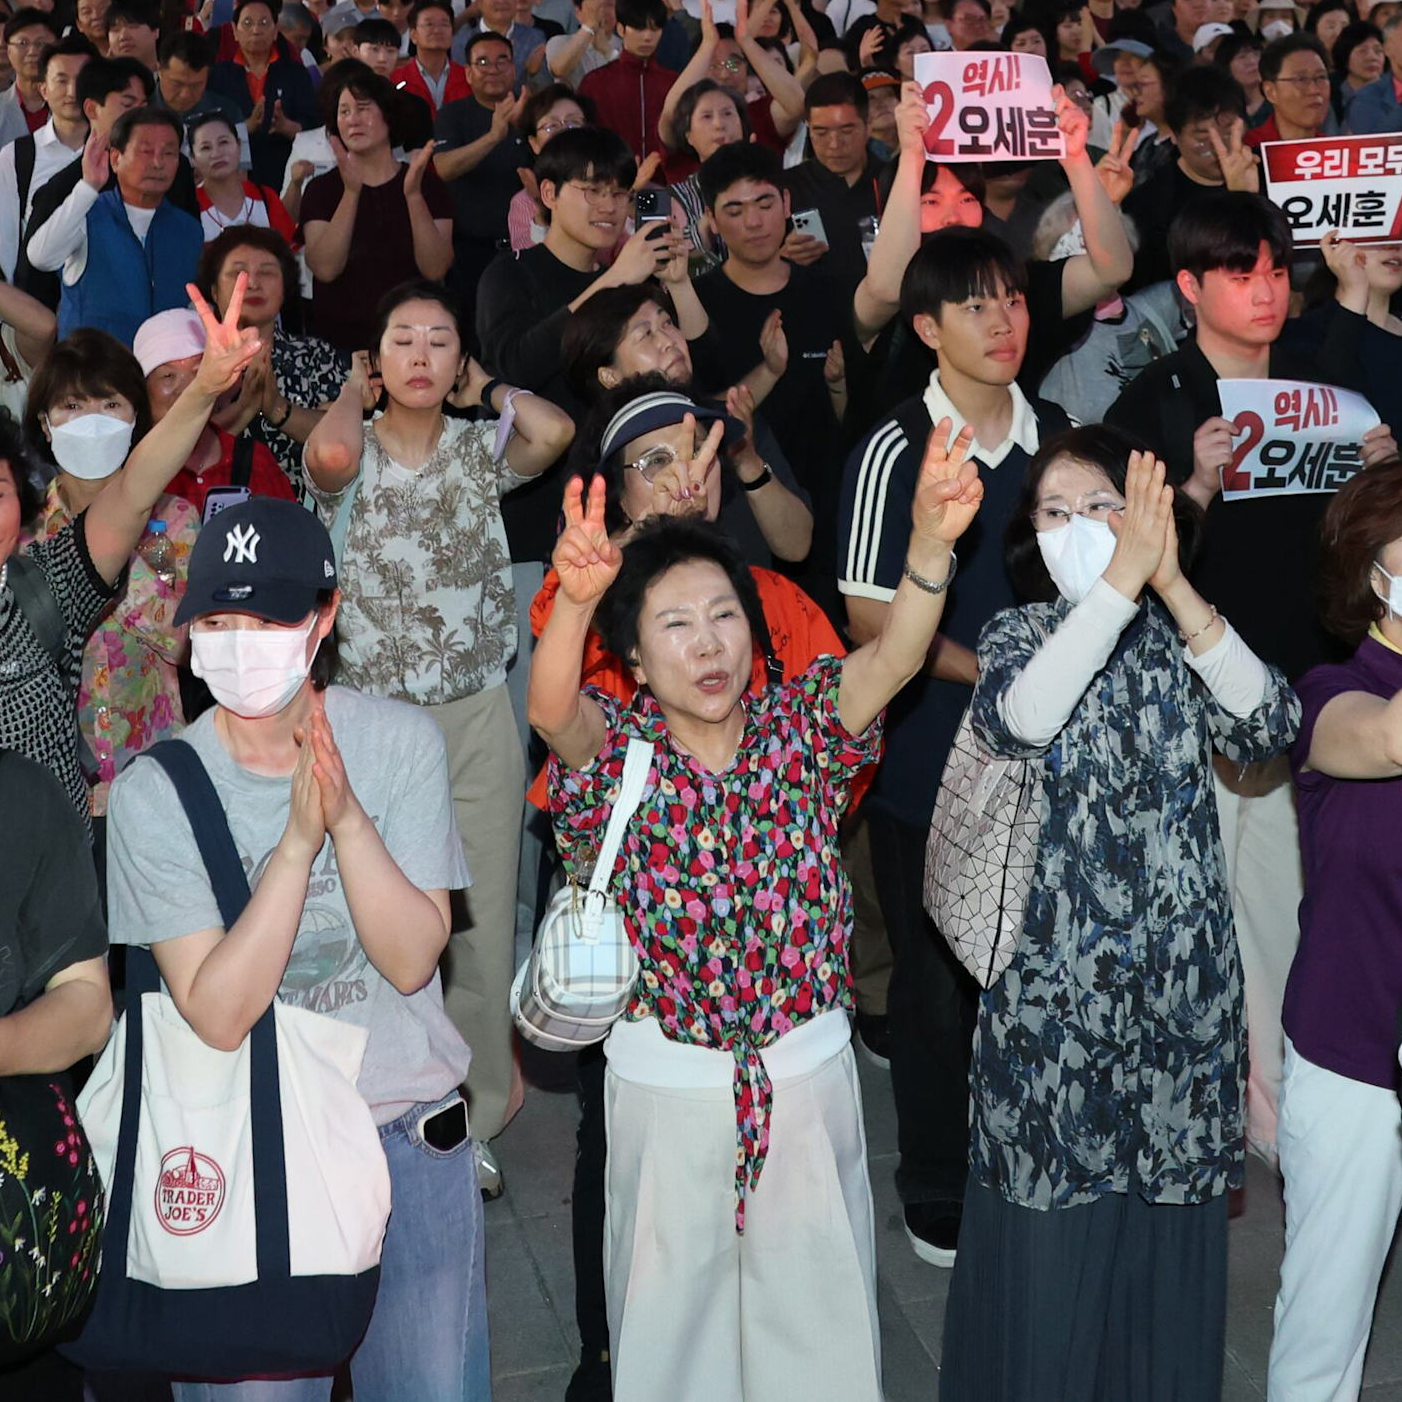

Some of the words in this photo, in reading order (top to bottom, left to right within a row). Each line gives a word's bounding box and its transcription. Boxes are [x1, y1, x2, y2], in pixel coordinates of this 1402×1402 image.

[961, 53, 1021, 98] 역시!
[923, 80, 955, 156] 2
[958, 107, 1061, 158] 오세훈
[1295, 148, 1347, 180] 우리
[1282, 190, 1388, 230] 오세훈
[1274, 388, 1339, 432] 역시!
[1224, 410, 1265, 493] 2
[1254, 439, 1366, 490] 오세훈
[223, 523, 261, 563] NY
[162, 1189, 216, 1207] TRADER
[164, 1204, 208, 1222] JOE'S
